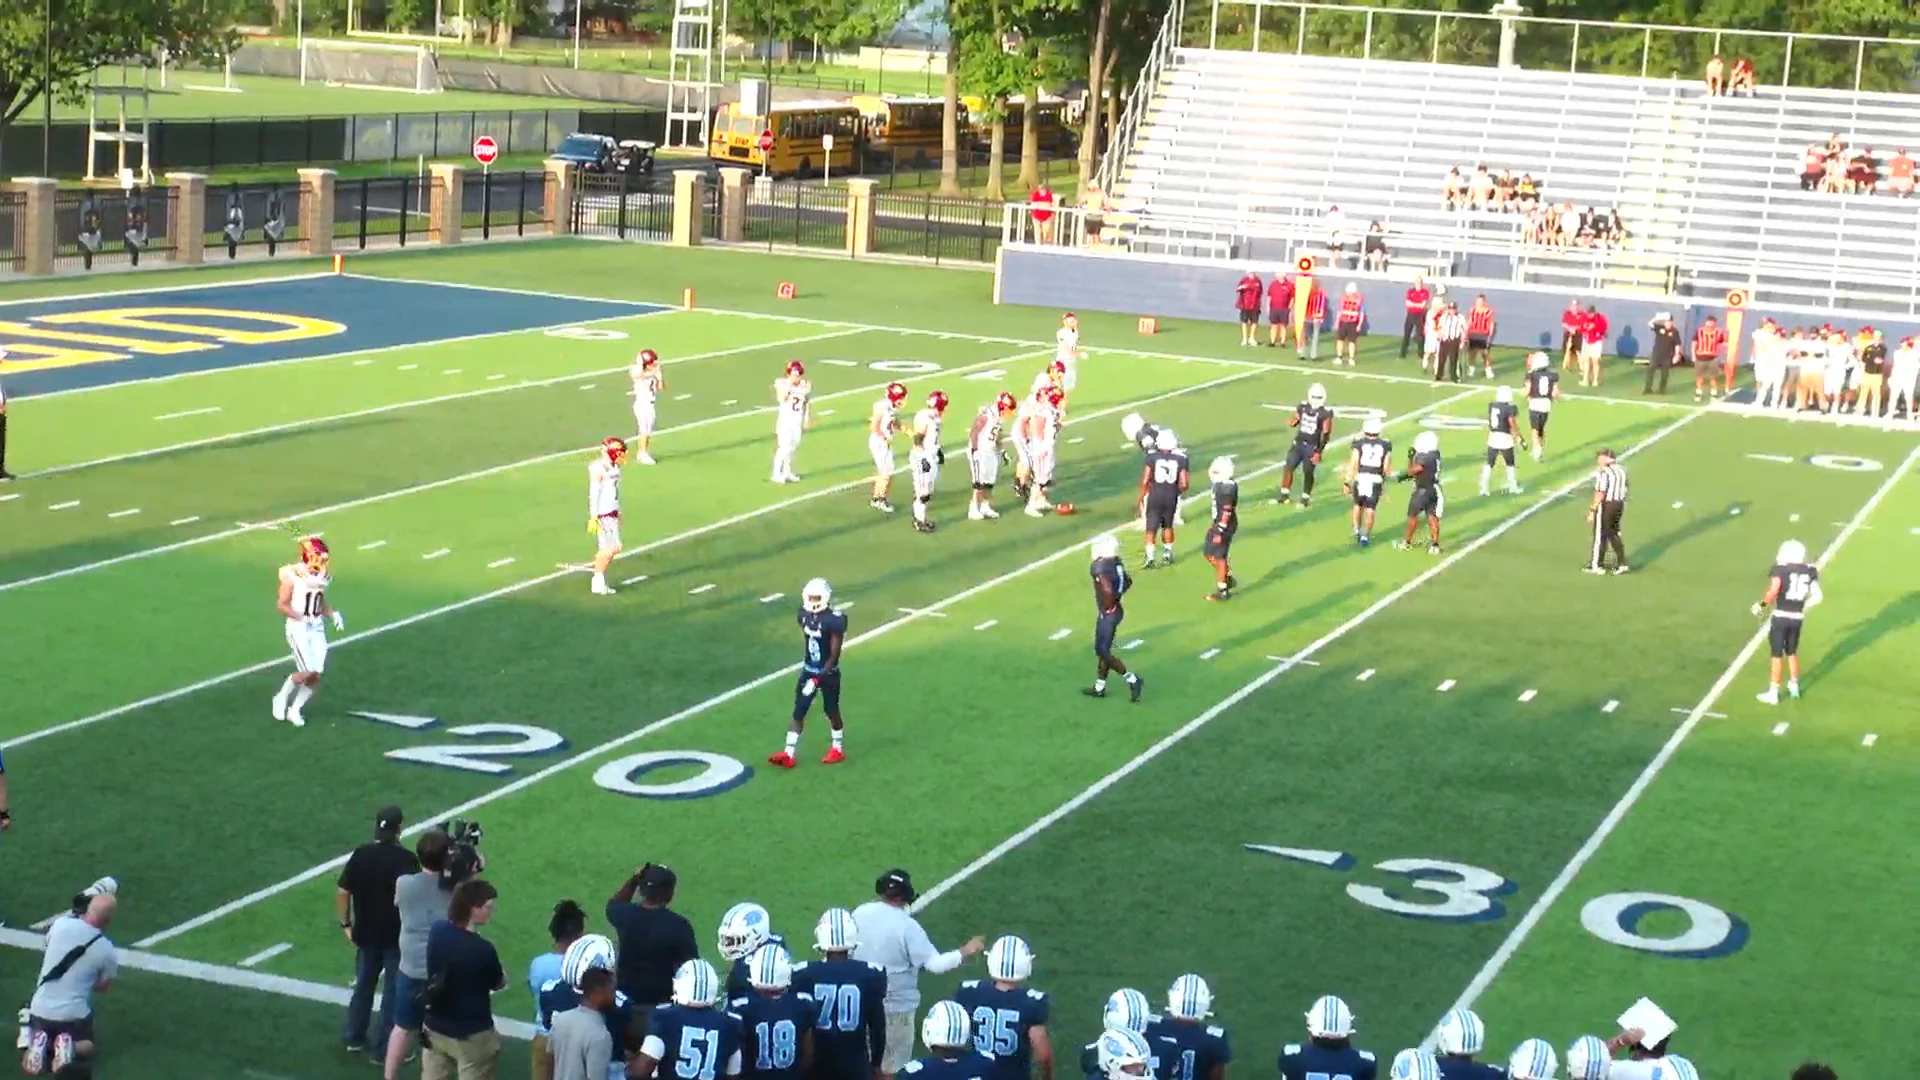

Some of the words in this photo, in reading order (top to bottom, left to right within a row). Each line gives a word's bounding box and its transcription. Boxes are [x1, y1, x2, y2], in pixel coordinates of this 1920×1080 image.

[475, 144, 497, 155] STOP
[303, 591, 324, 617] 10
[814, 983, 861, 1032] 70
[972, 1005, 1020, 1056] 35
[675, 1024, 719, 1080] 51
[755, 1019, 796, 1069] 18
